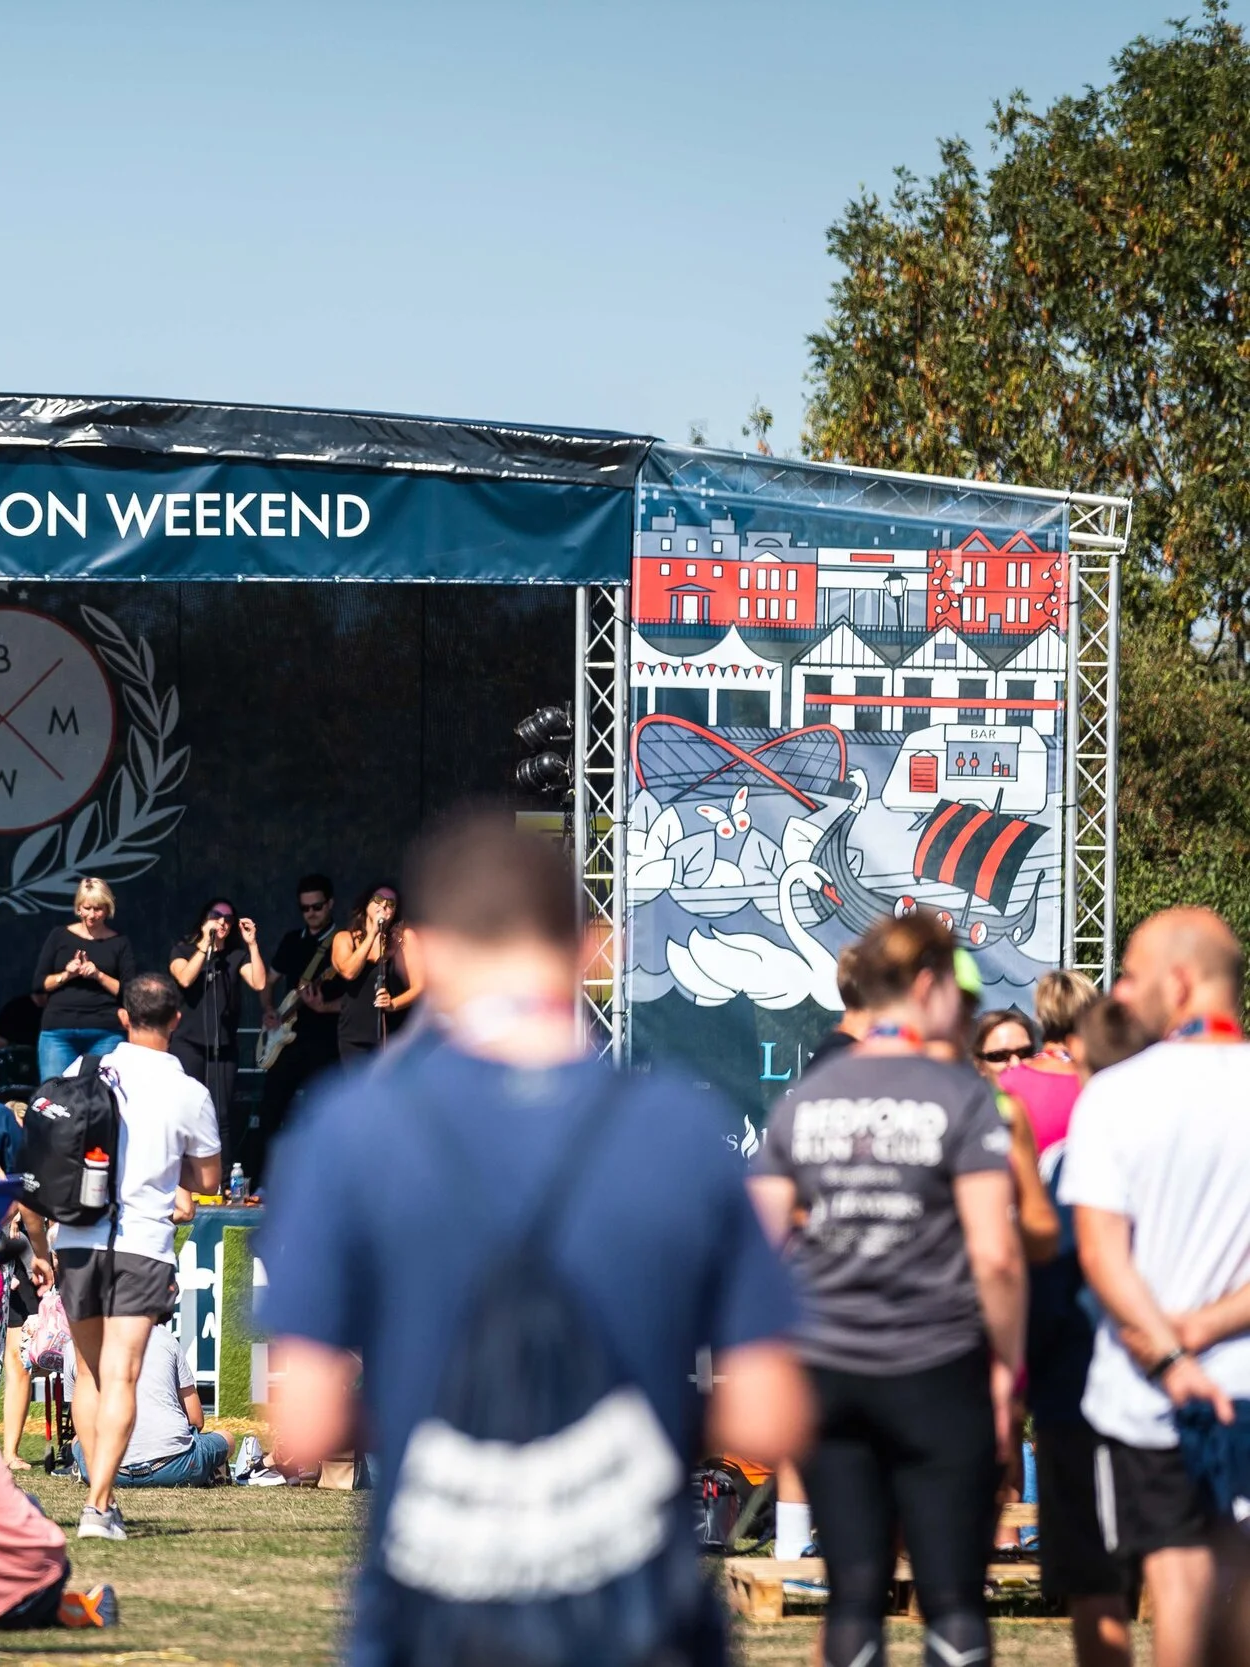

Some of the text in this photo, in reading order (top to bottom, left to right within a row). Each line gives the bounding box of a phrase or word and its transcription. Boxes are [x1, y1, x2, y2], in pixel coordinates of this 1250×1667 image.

[106, 491, 372, 540] WEEKEND
[48, 706, 80, 736] M
[970, 728, 997, 740] BAR
[759, 1042, 792, 1081] L
